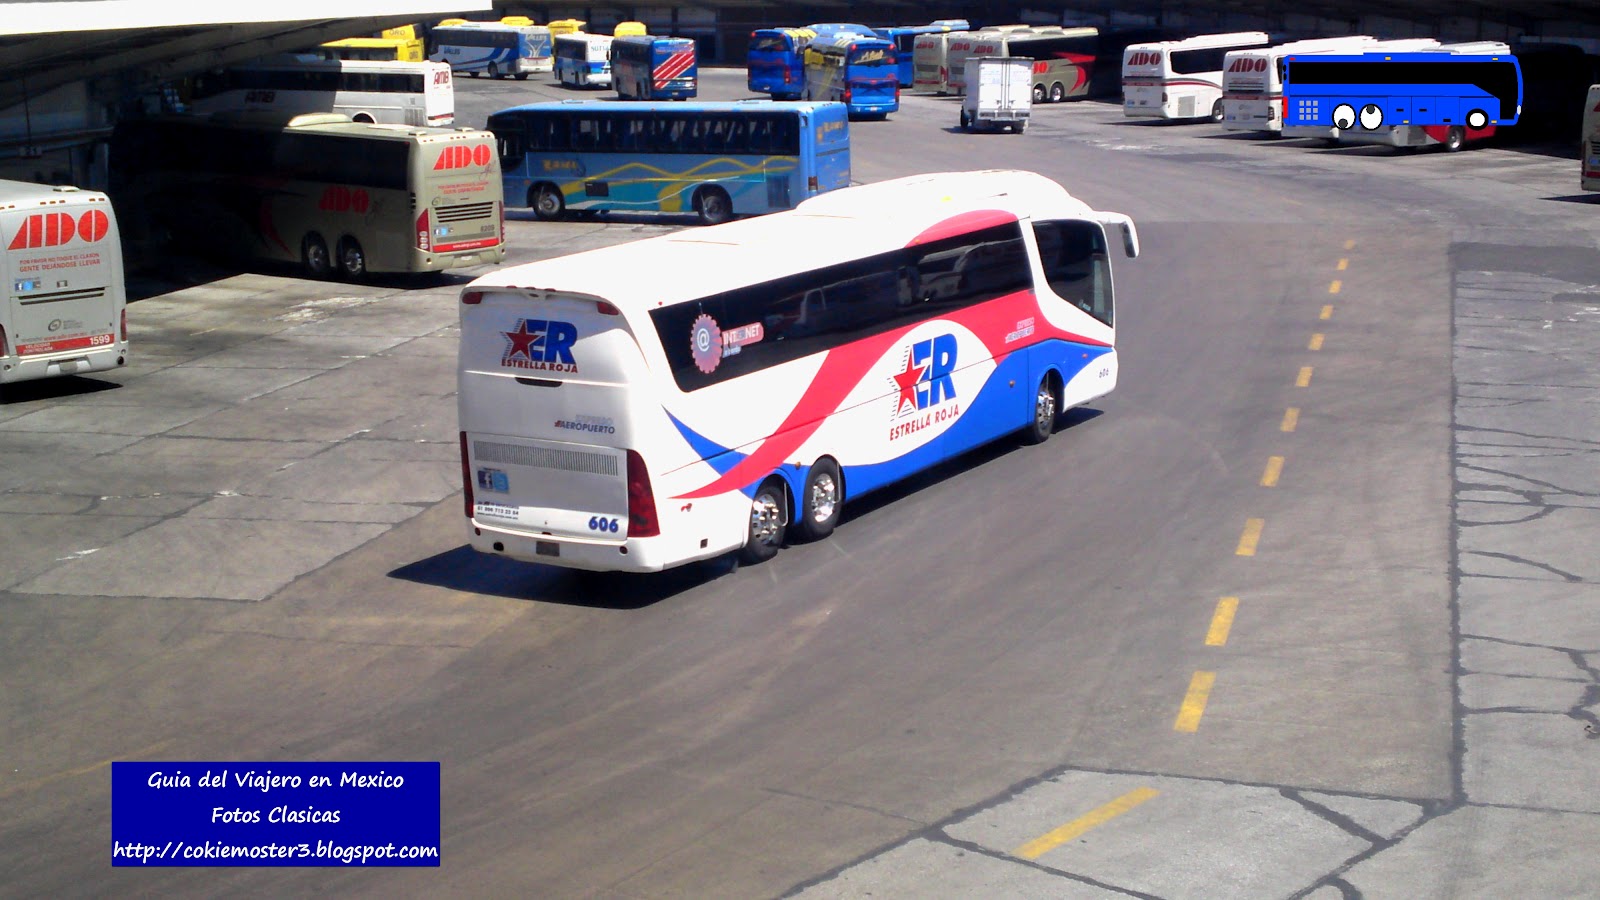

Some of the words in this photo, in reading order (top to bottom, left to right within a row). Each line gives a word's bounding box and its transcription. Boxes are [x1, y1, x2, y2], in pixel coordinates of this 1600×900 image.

[951, 43, 970, 51] ADO
[974, 45, 993, 53] ADO
[1127, 53, 1162, 65] ADO
[1228, 58, 1267, 72] ADO
[433, 144, 491, 170] ADO
[319, 187, 369, 214] ADO
[8, 210, 109, 250] ADO
[90, 334, 110, 345] 1599
[501, 359, 547, 371] ESTRELLA
[549, 361, 578, 374] ROJA
[560, 419, 616, 434] AEROPUERTO
[889, 412, 932, 441] ESTRELLA
[934, 403, 960, 423] ROJA
[588, 516, 619, 533] 606
